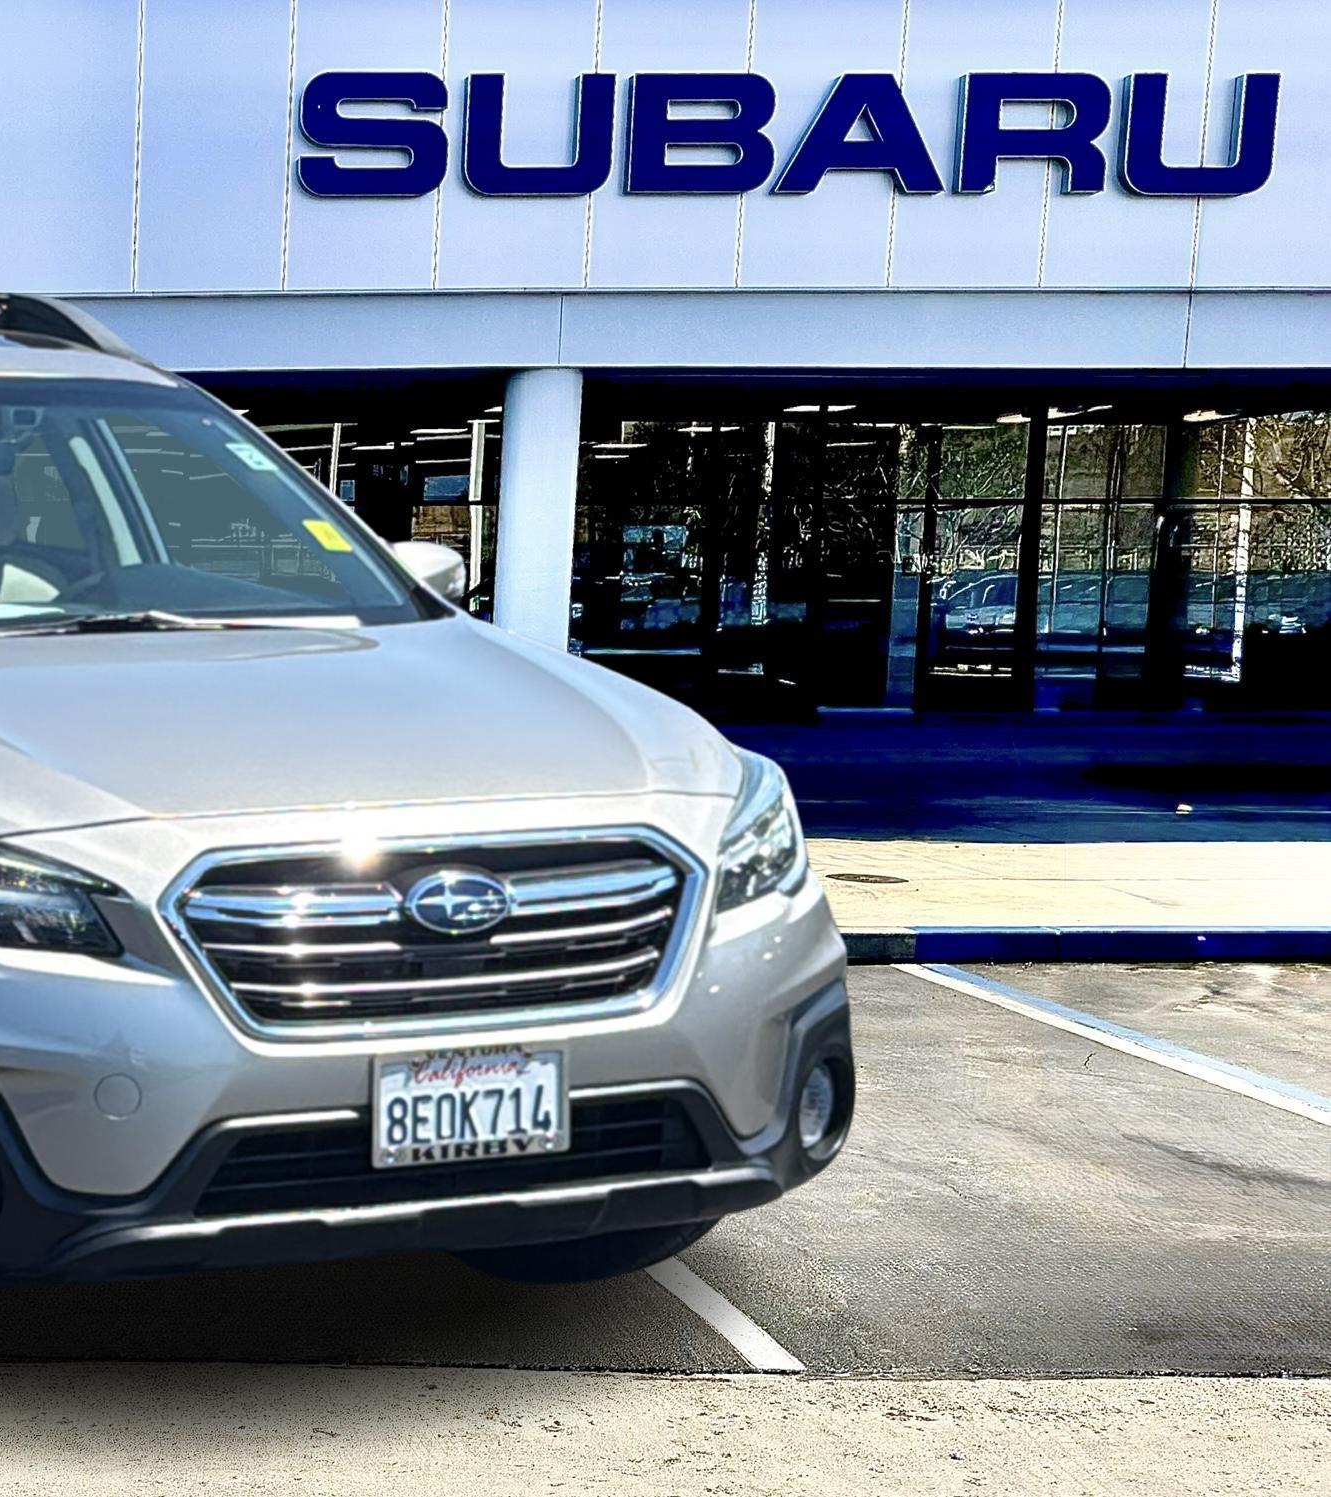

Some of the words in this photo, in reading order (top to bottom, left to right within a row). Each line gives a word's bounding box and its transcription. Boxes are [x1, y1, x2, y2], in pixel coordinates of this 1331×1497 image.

[296, 71, 1281, 197] SUBARU
[413, 1059, 519, 1087] California
[411, 1137, 535, 1161] KIRBY
